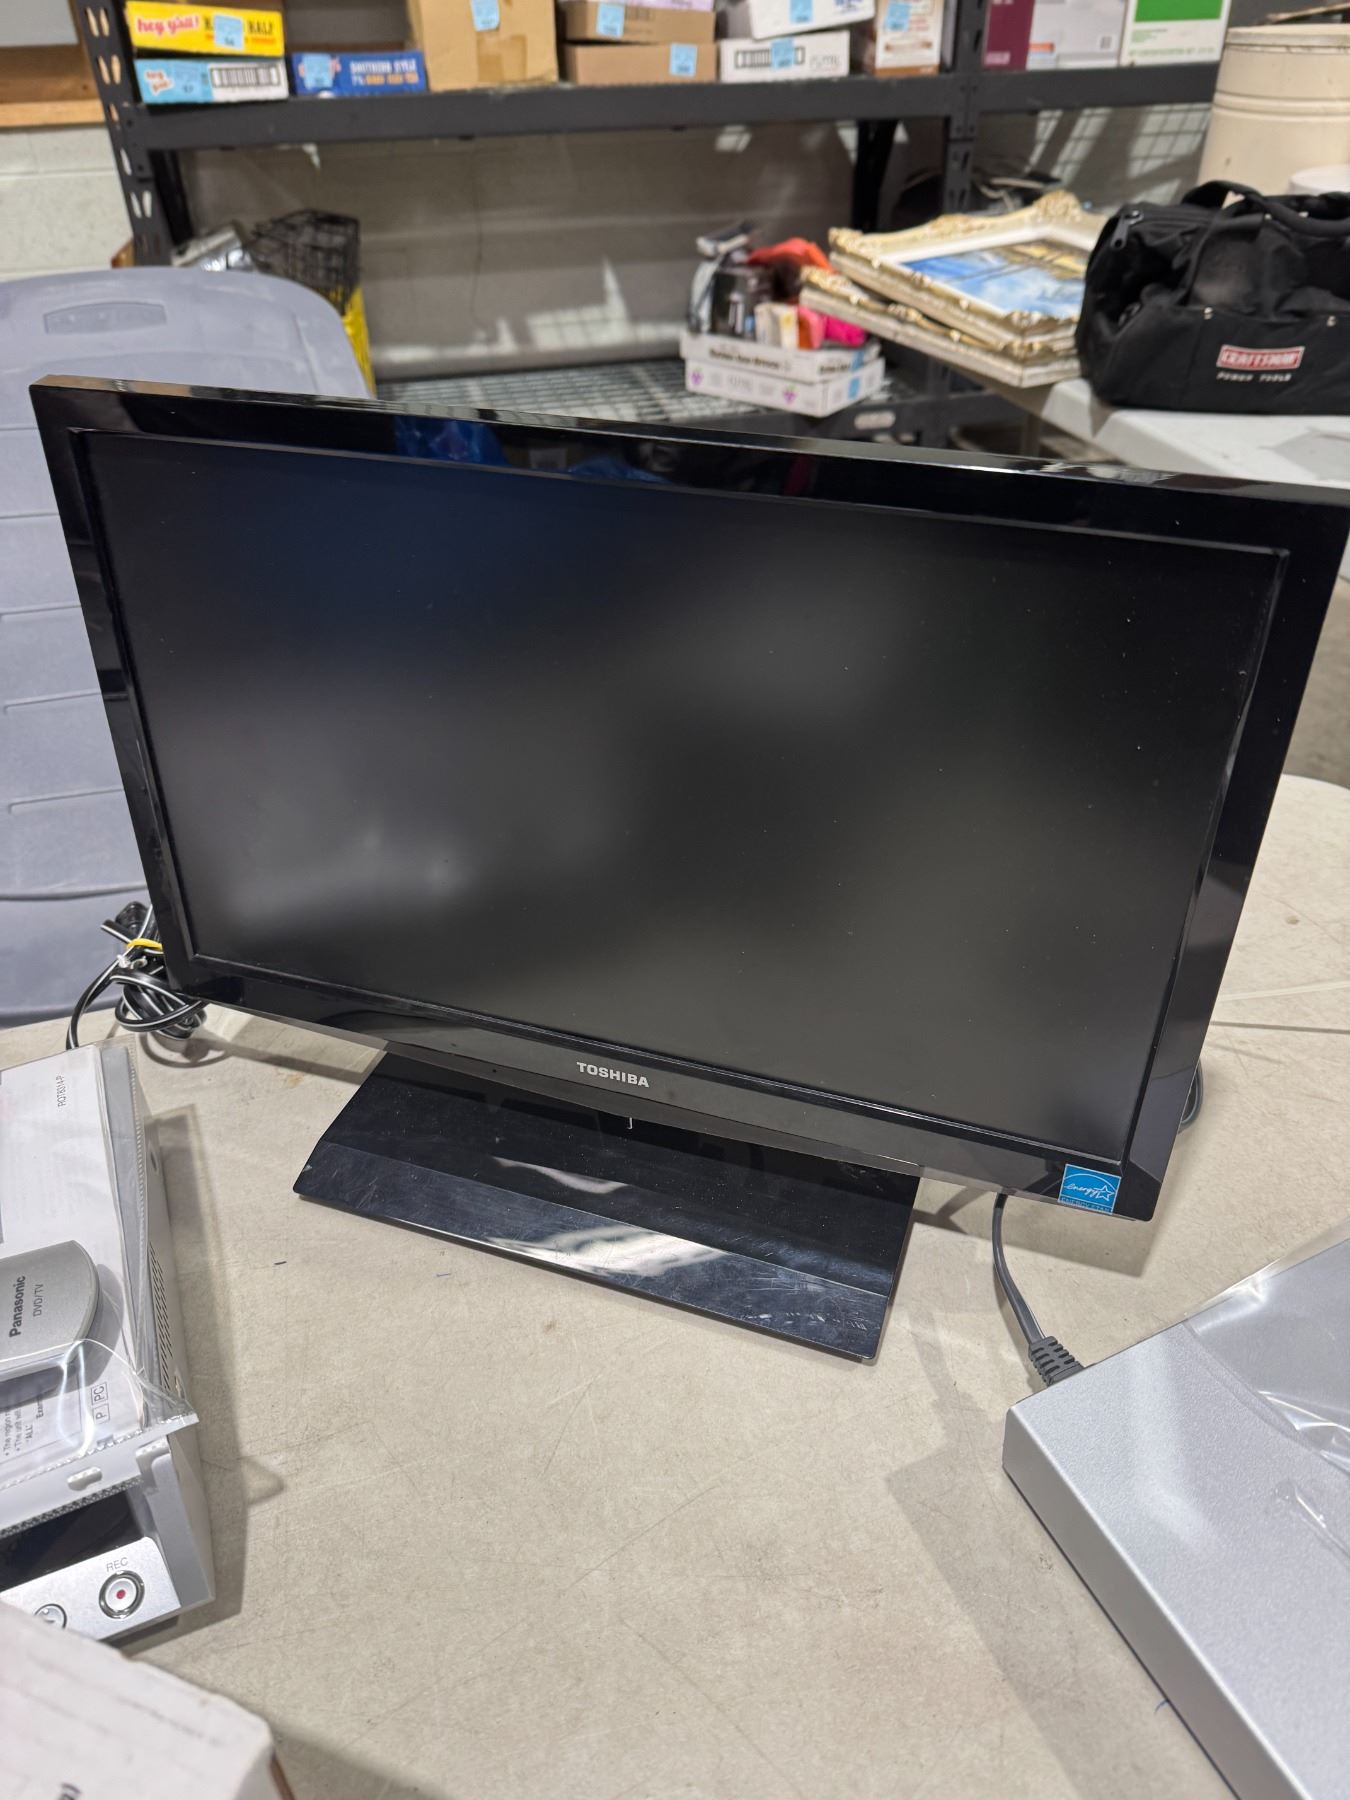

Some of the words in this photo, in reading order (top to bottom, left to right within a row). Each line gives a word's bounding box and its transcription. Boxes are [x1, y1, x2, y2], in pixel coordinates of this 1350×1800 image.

[576, 1061, 650, 1088] TOSHIBA
[8, 1275, 26, 1338] Panasonic
[32, 1283, 44, 1317] DVD/TV
[105, 1556, 129, 1573] REC
